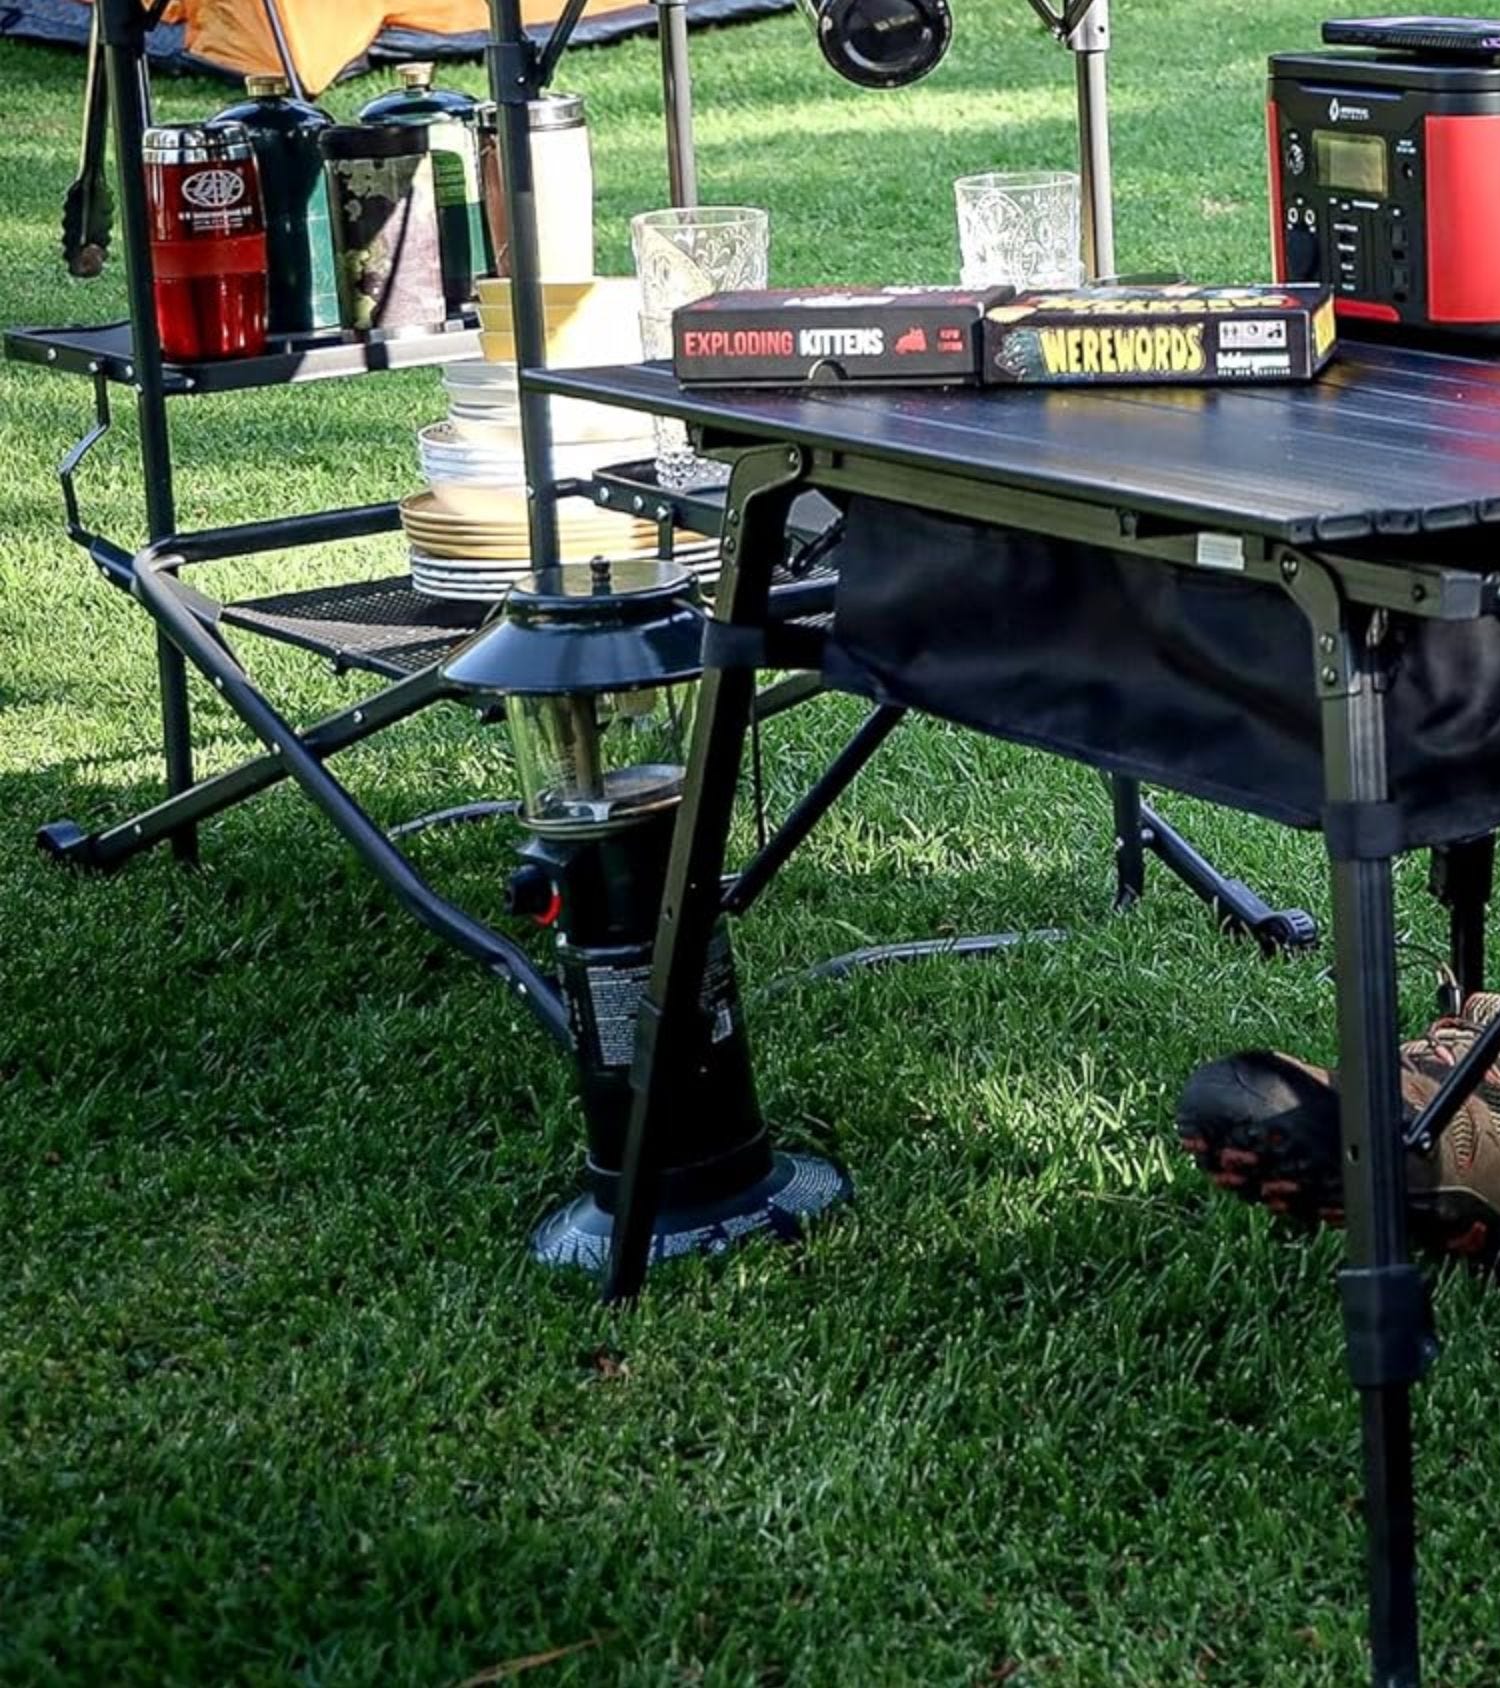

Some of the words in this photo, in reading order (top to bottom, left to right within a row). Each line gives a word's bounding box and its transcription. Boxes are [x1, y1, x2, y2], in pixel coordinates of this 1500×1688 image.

[684, 330, 793, 357] EXPLODING
[799, 327, 885, 356] KITTENS
[1040, 323, 1204, 374] WEREWORDS
